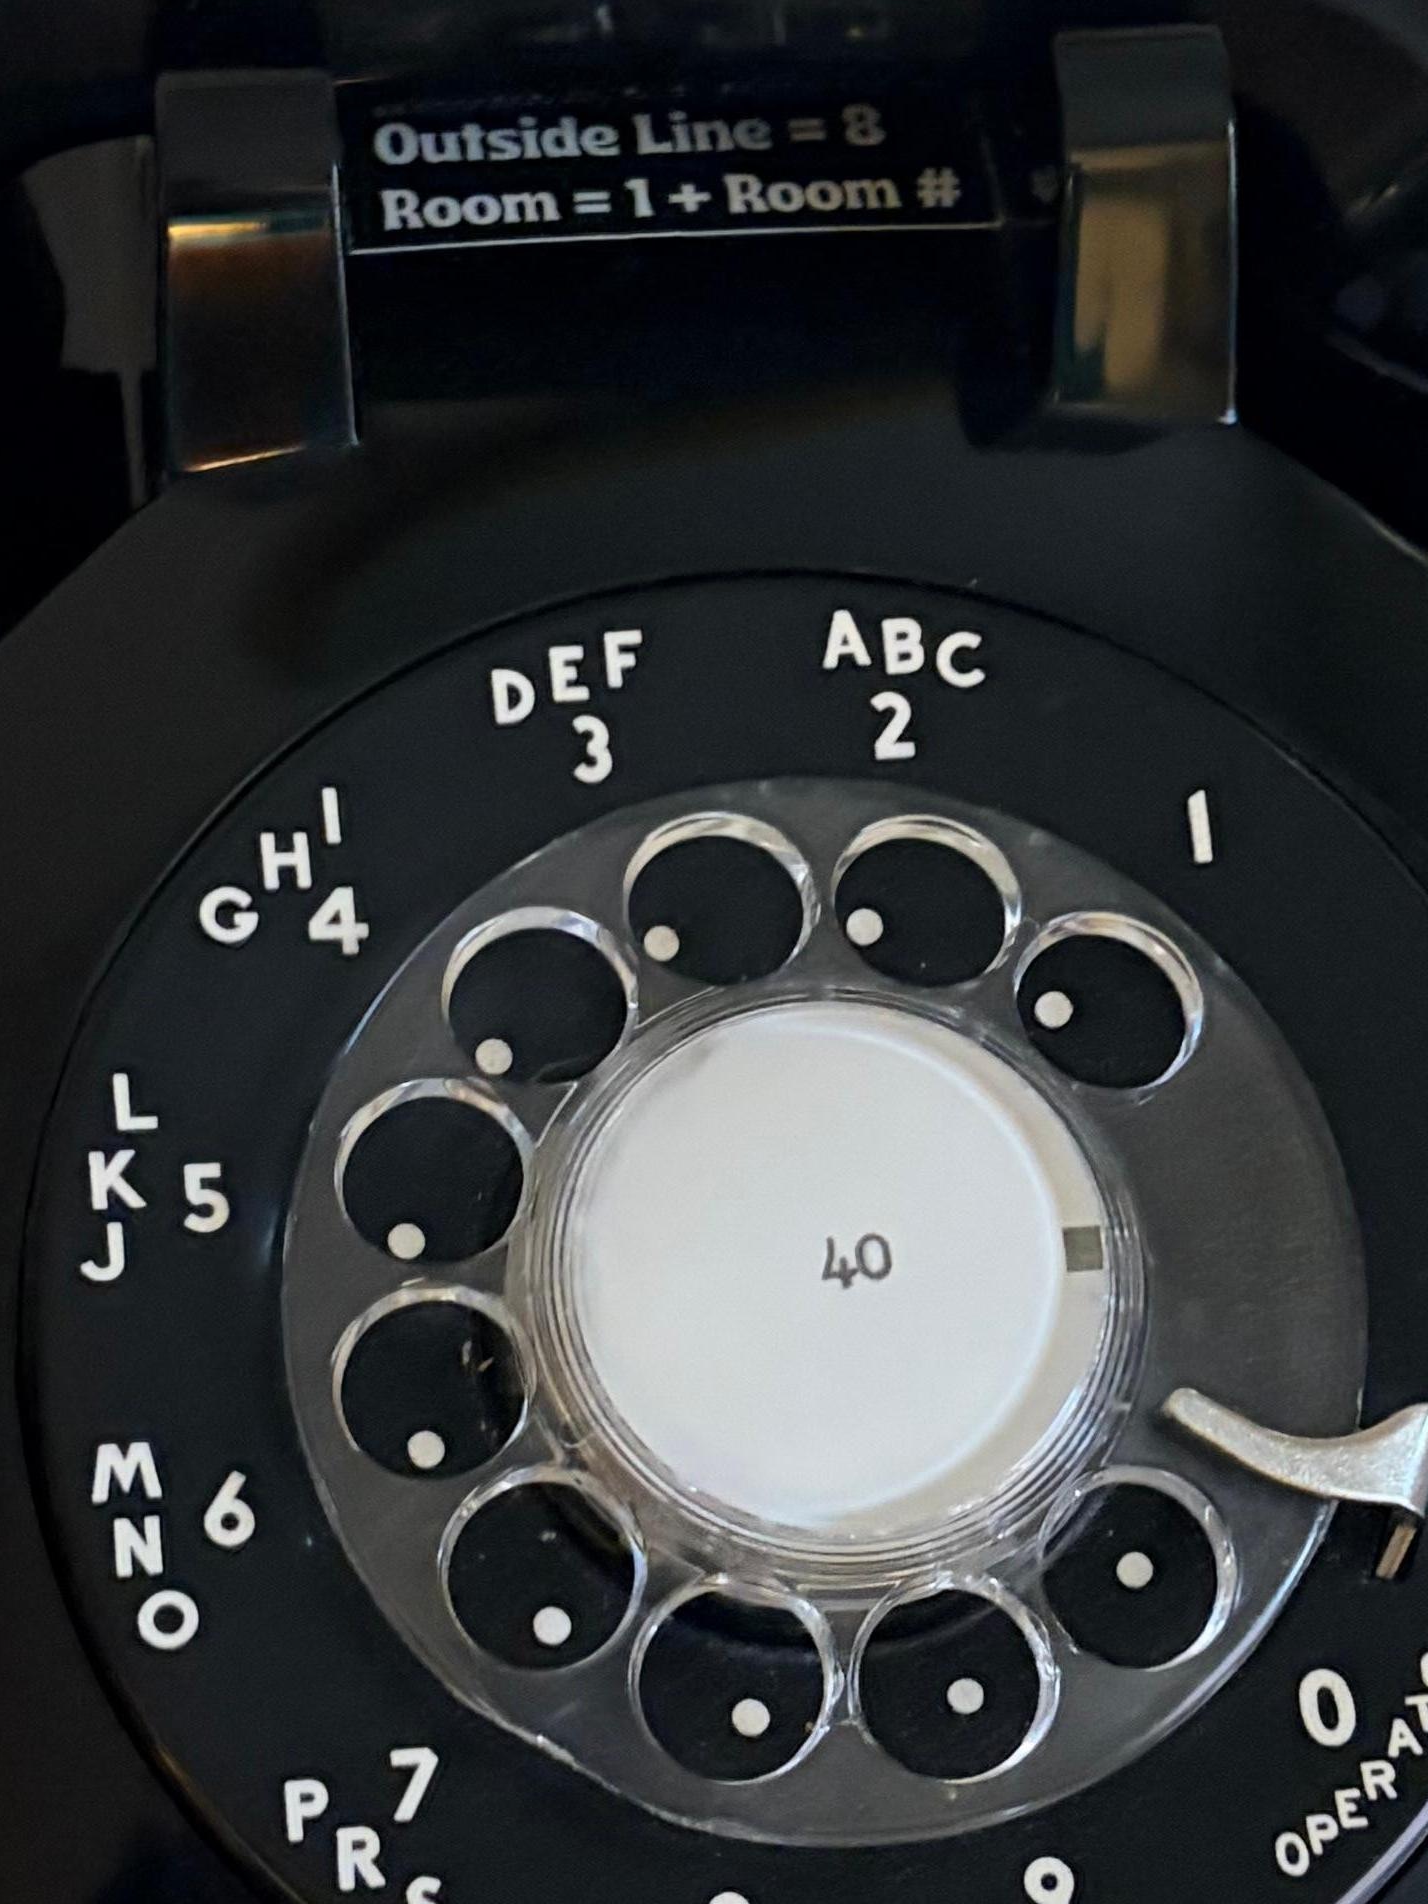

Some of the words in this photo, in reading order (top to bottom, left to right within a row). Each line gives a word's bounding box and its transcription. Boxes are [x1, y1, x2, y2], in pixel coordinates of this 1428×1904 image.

[374, 117, 620, 165] Outside
[632, 109, 773, 156] Line
[788, 115, 827, 143] =
[840, 103, 886, 148] 8
[380, 188, 561, 231] Room
[574, 191, 611, 214] =
[625, 178, 654, 218] 1
[668, 183, 712, 212] +
[724, 173, 902, 214] Room
[916, 167, 961, 209] #
[490, 628, 644, 726] DEF
[822, 608, 986, 689] ABC
[571, 714, 614, 784] 3
[869, 690, 917, 761] 2
[307, 885, 370, 956] 4
[182, 1161, 231, 1234] 5
[821, 1232, 893, 1289] 40
[203, 1469, 257, 1548] 6
[388, 1746, 440, 1823] 7
